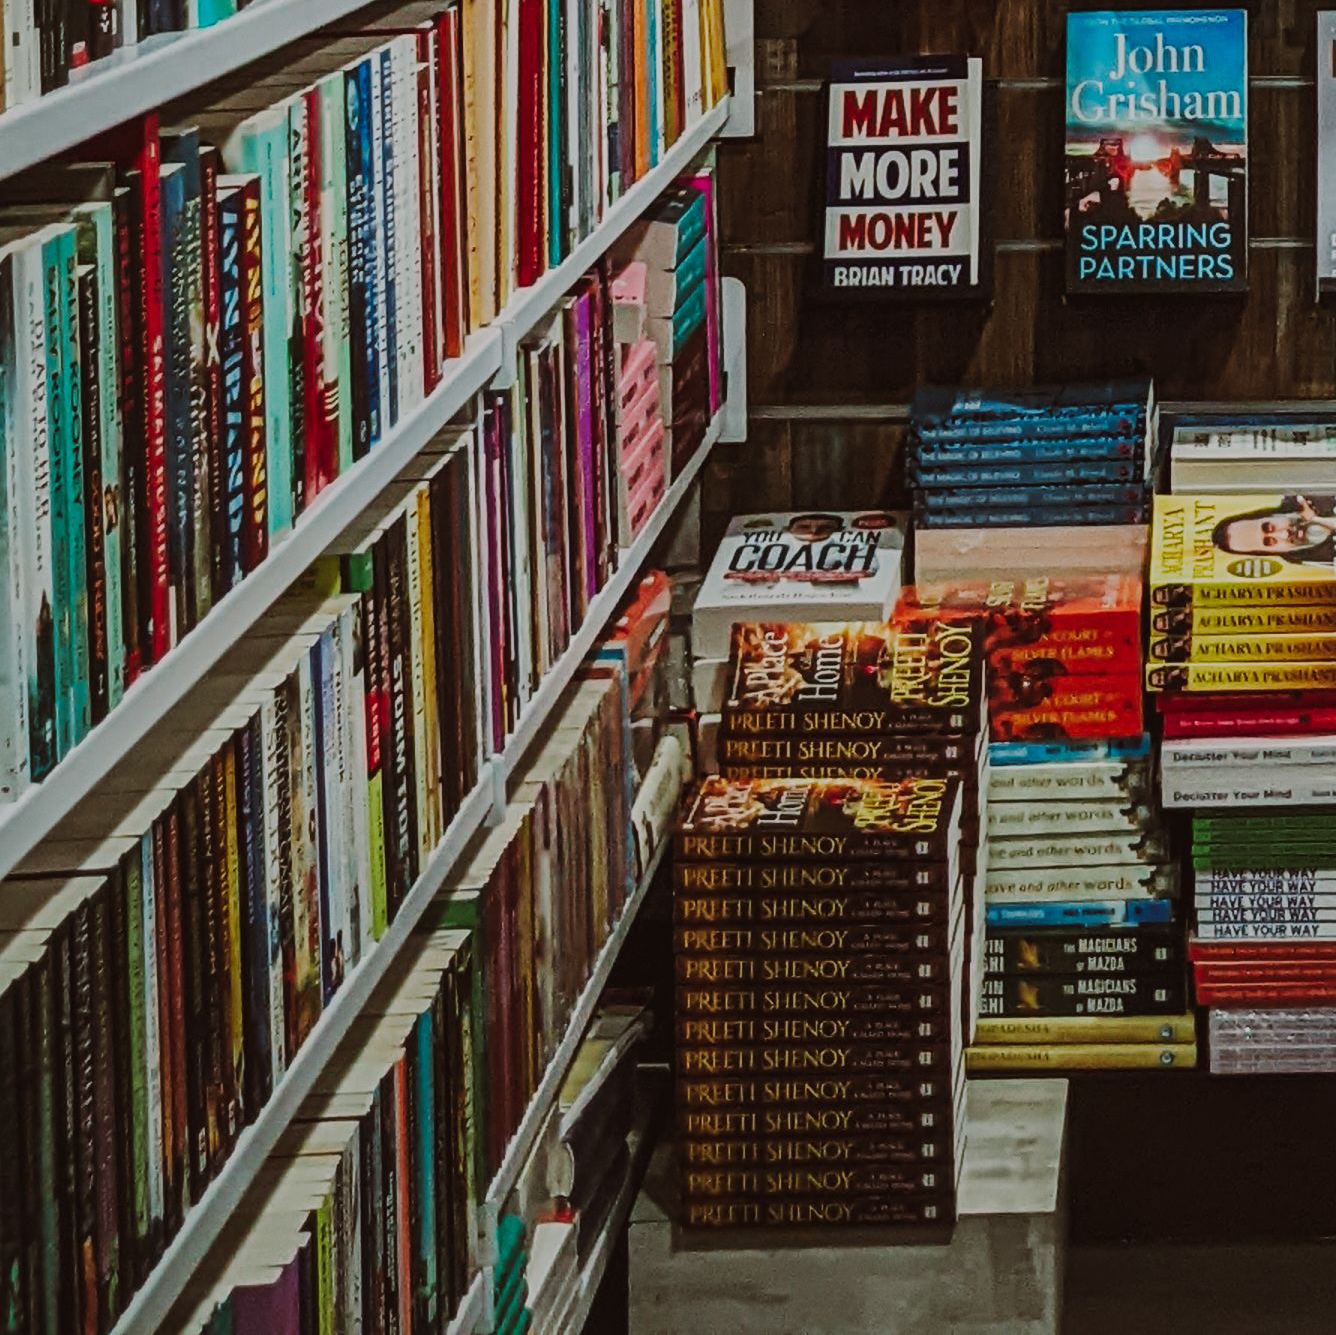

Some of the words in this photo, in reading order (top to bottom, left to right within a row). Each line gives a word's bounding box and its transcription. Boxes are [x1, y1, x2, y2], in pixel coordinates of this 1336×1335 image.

[1110, 32, 1205, 80] John
[842, 86, 958, 138] MAKE
[1071, 80, 1242, 123] Grisham
[840, 149, 959, 200] MORE
[839, 211, 957, 251] MONEY
[1080, 222, 1230, 251] SPARRING
[834, 266, 894, 287] BRIAN
[900, 265, 962, 286] TRACY
[1080, 254, 1234, 280] PARTNERS
[742, 530, 783, 544] YOU
[840, 530, 882, 545] CAN
[729, 544, 877, 574] COACH
[799, 633, 844, 701] Home
[928, 621, 973, 707] SHENOY
[805, 711, 886, 731] SHENOY
[1214, 924, 1249, 937] HAVE
[1252, 924, 1288, 937] YOUR
[1291, 923, 1319, 936] WAY
